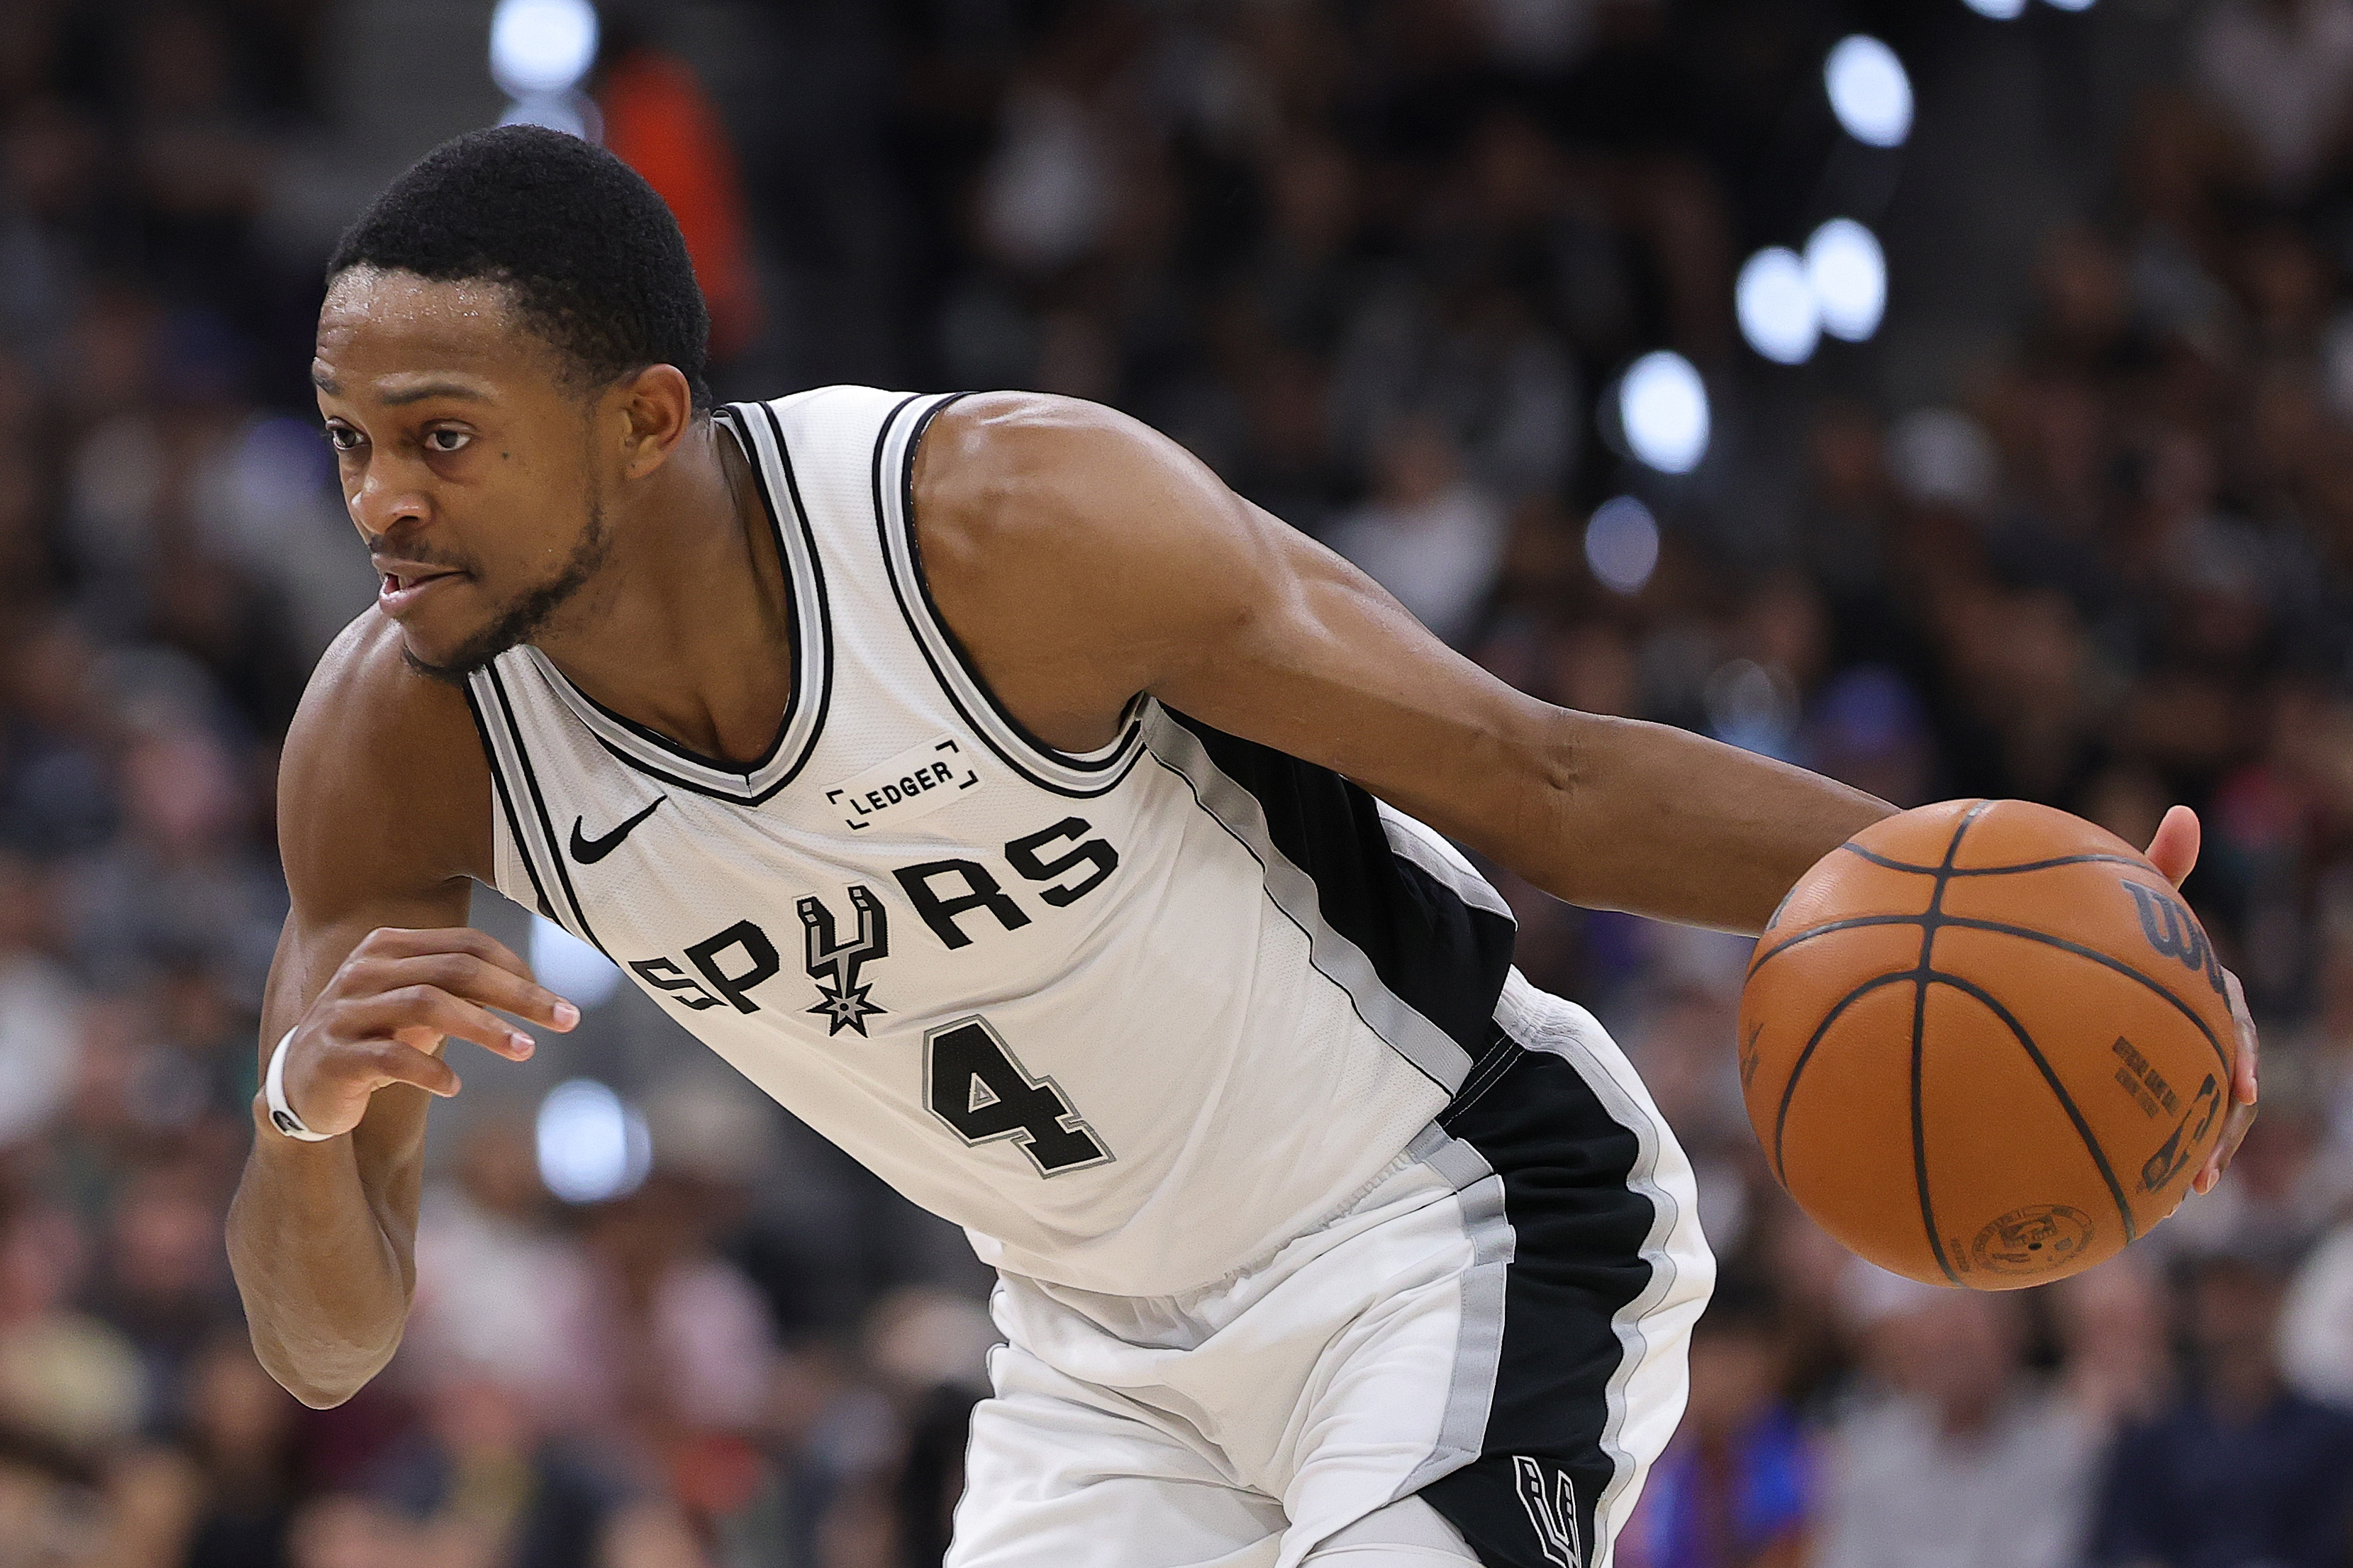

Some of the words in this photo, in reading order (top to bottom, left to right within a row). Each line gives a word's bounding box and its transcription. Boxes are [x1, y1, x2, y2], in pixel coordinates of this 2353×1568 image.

[850, 761, 953, 816] LEDGER
[628, 816, 1119, 1038] SPURS
[923, 1014, 1116, 1179] 4
